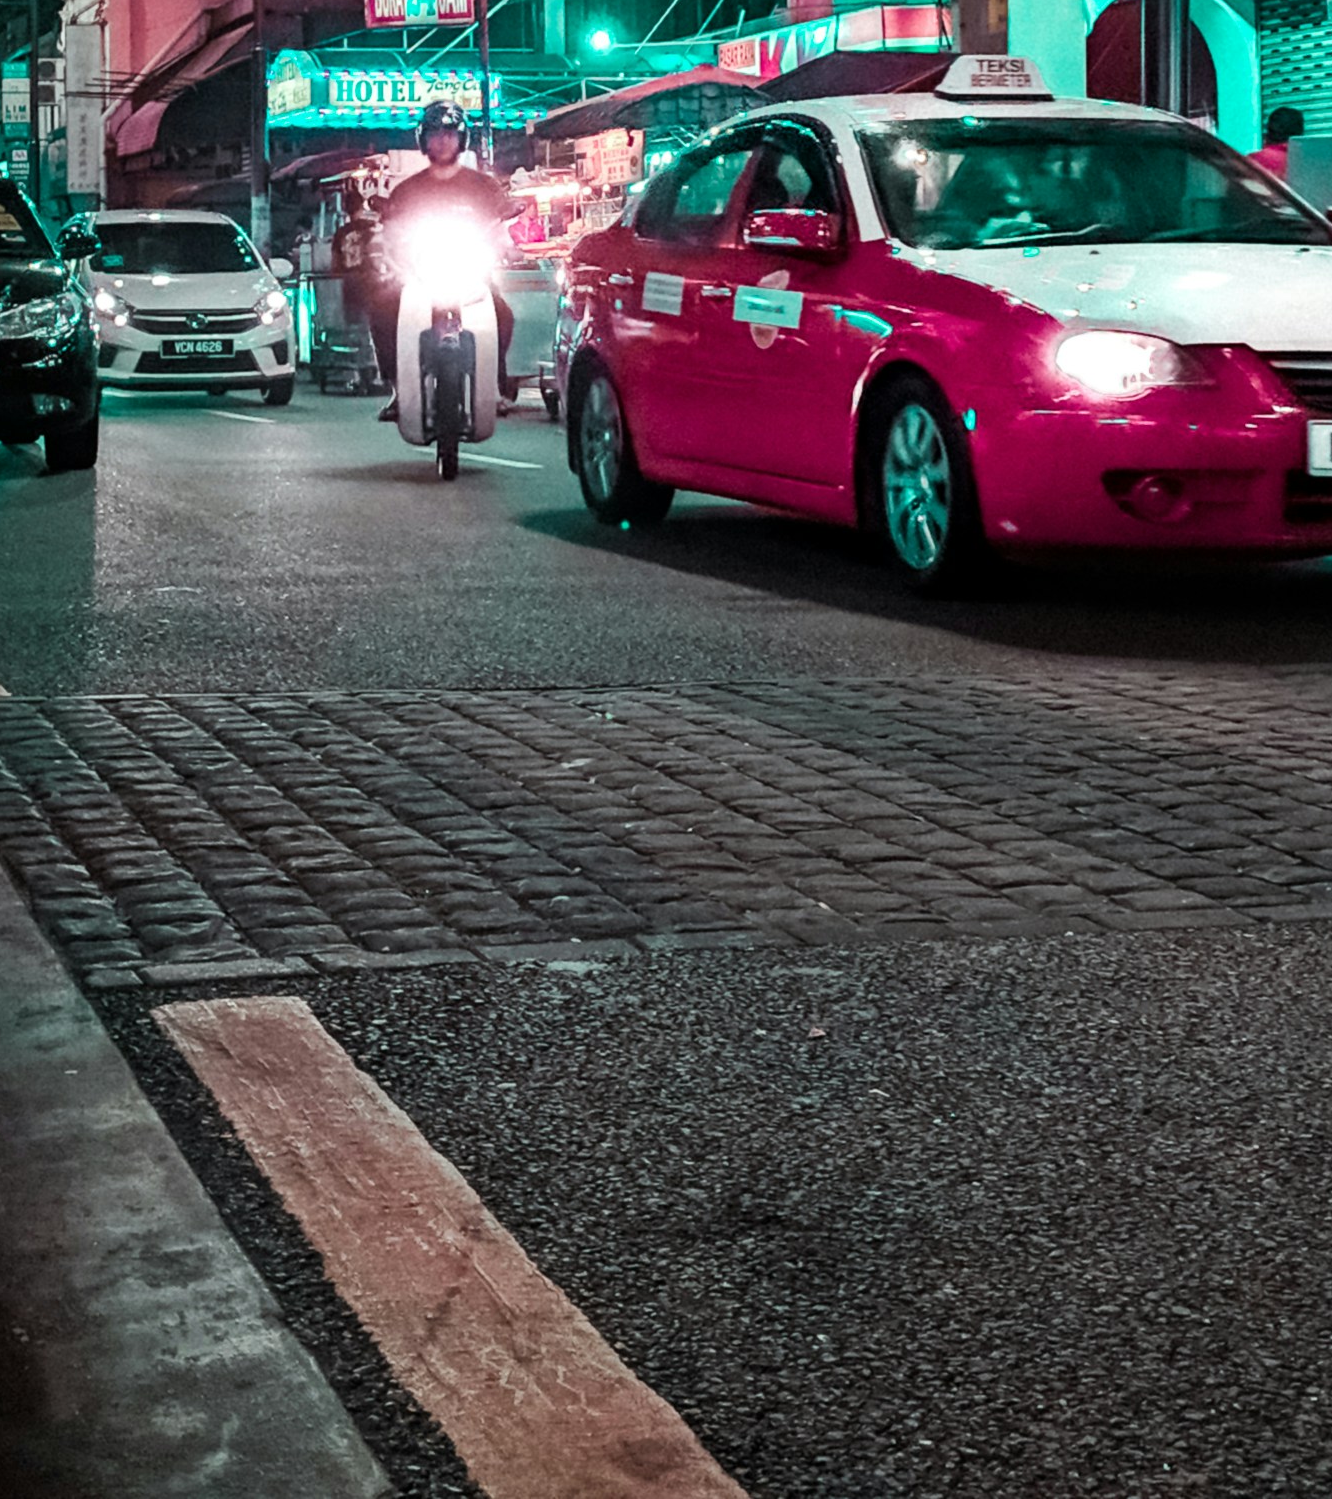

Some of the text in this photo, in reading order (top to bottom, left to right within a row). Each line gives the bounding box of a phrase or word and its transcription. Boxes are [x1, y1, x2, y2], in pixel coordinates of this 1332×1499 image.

[975, 58, 1025, 73] TEKSI
[336, 79, 421, 102] HOTEL
[425, 78, 461, 95] Tang
[174, 341, 224, 354] VCN 4626
